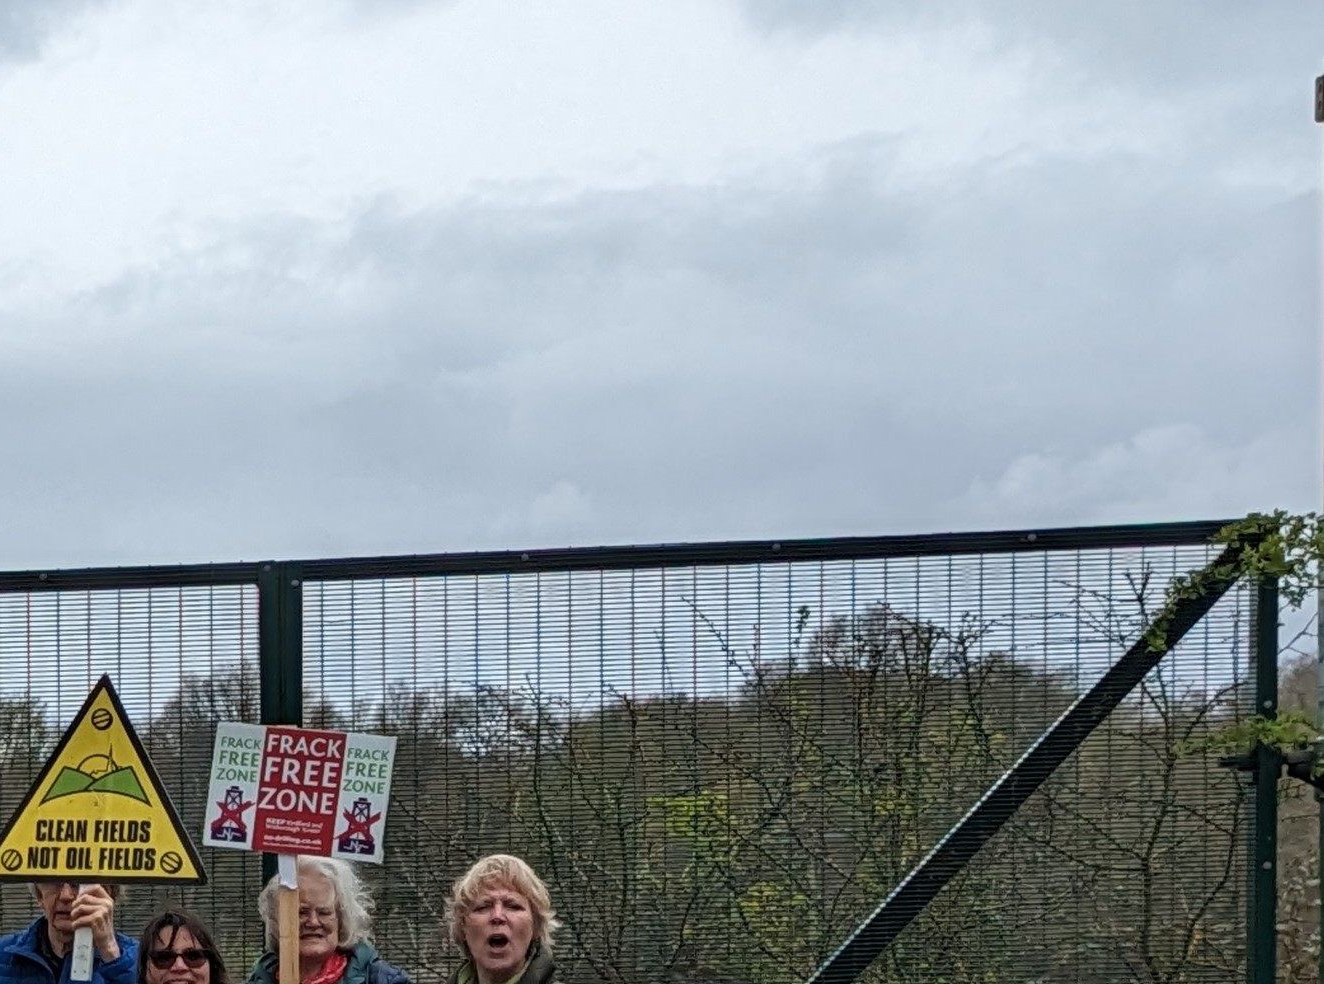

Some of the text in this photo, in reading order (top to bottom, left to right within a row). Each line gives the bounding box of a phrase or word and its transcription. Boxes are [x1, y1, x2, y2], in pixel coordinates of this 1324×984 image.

[220, 736, 262, 750] FRACK
[266, 734, 343, 759] FRACK
[218, 750, 260, 768] FREE
[347, 747, 390, 762] FRACK
[215, 767, 258, 783] ZONE
[263, 756, 340, 788] FREE
[345, 762, 388, 779] FREE
[342, 779, 386, 795] ZONE
[258, 787, 335, 815] ZONE
[35, 819, 151, 843] CLEAN FIELDS
[27, 847, 156, 871] NOT OIL FIELDS
